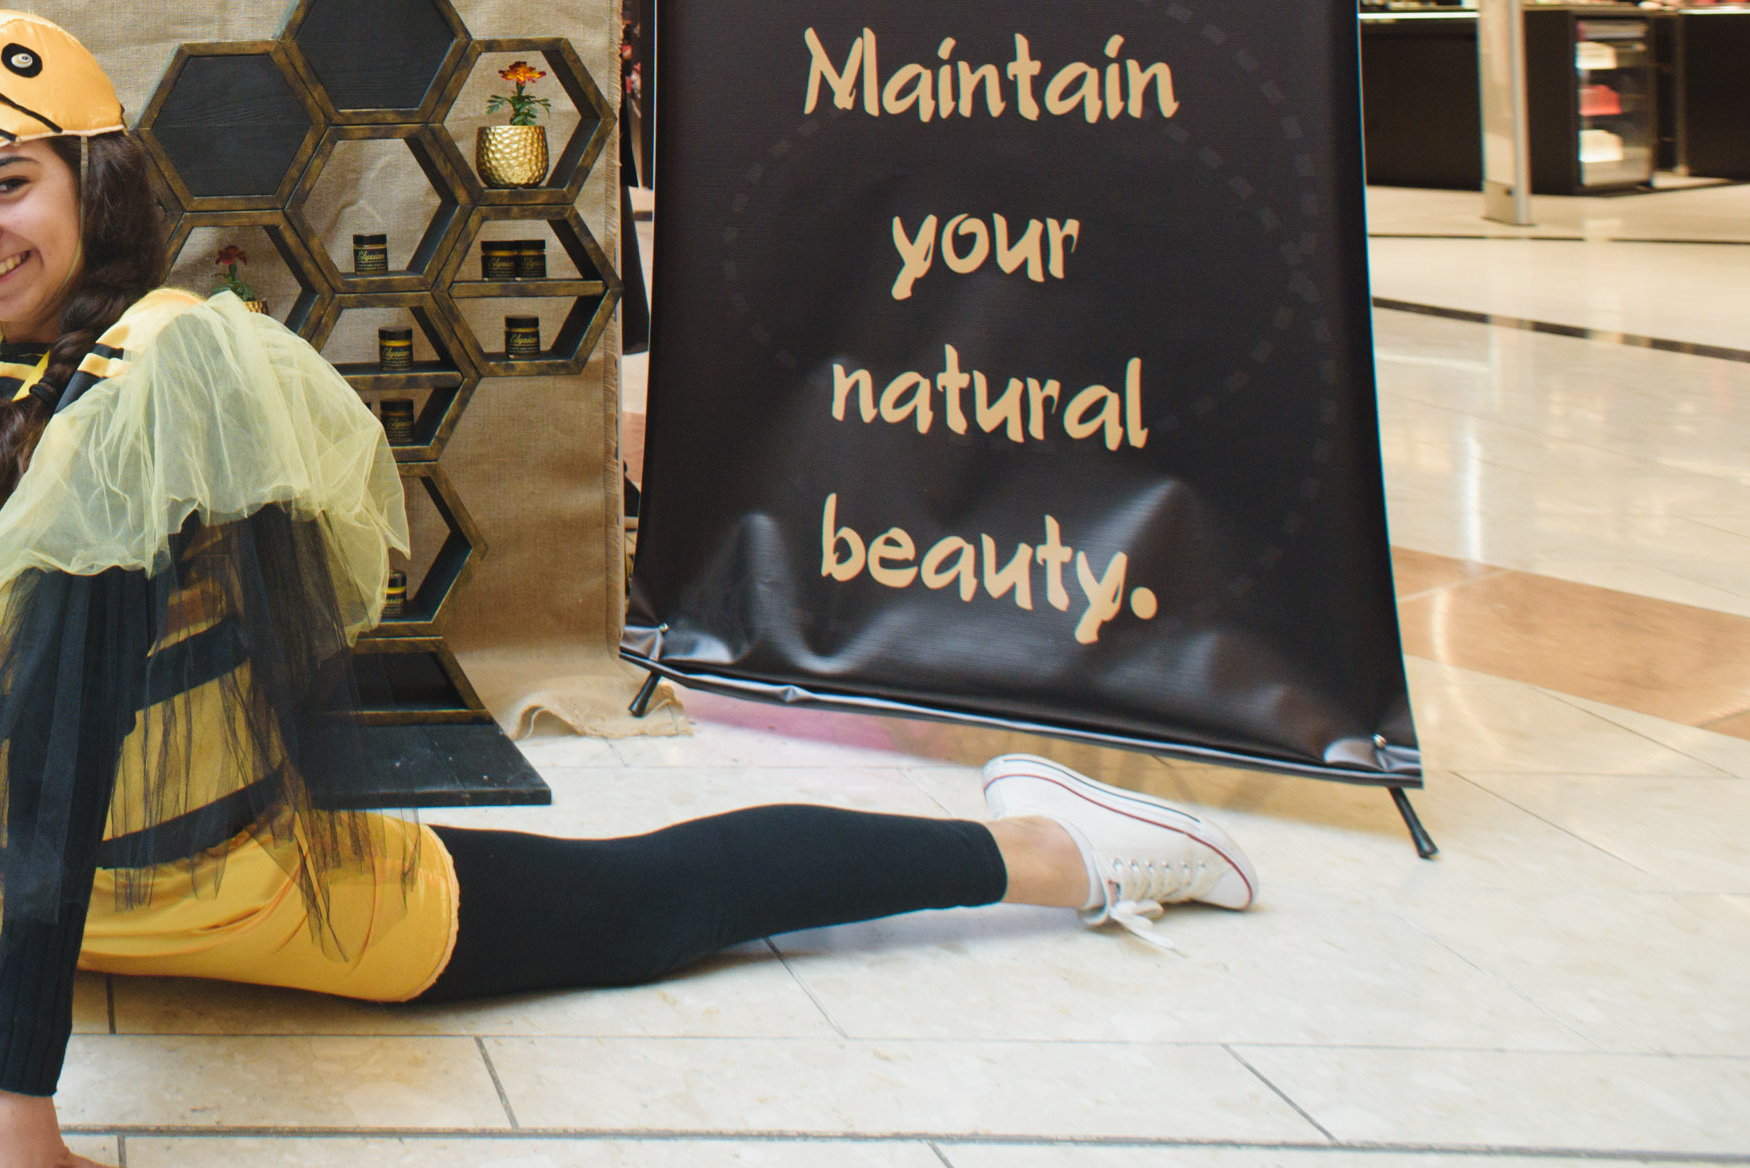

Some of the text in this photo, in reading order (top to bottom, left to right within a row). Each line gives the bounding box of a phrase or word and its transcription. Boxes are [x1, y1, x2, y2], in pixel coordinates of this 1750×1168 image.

[803, 27, 1180, 123] Maintain
[891, 213, 1080, 300] your
[831, 344, 1149, 451] natural
[821, 493, 1158, 644] beauty.
